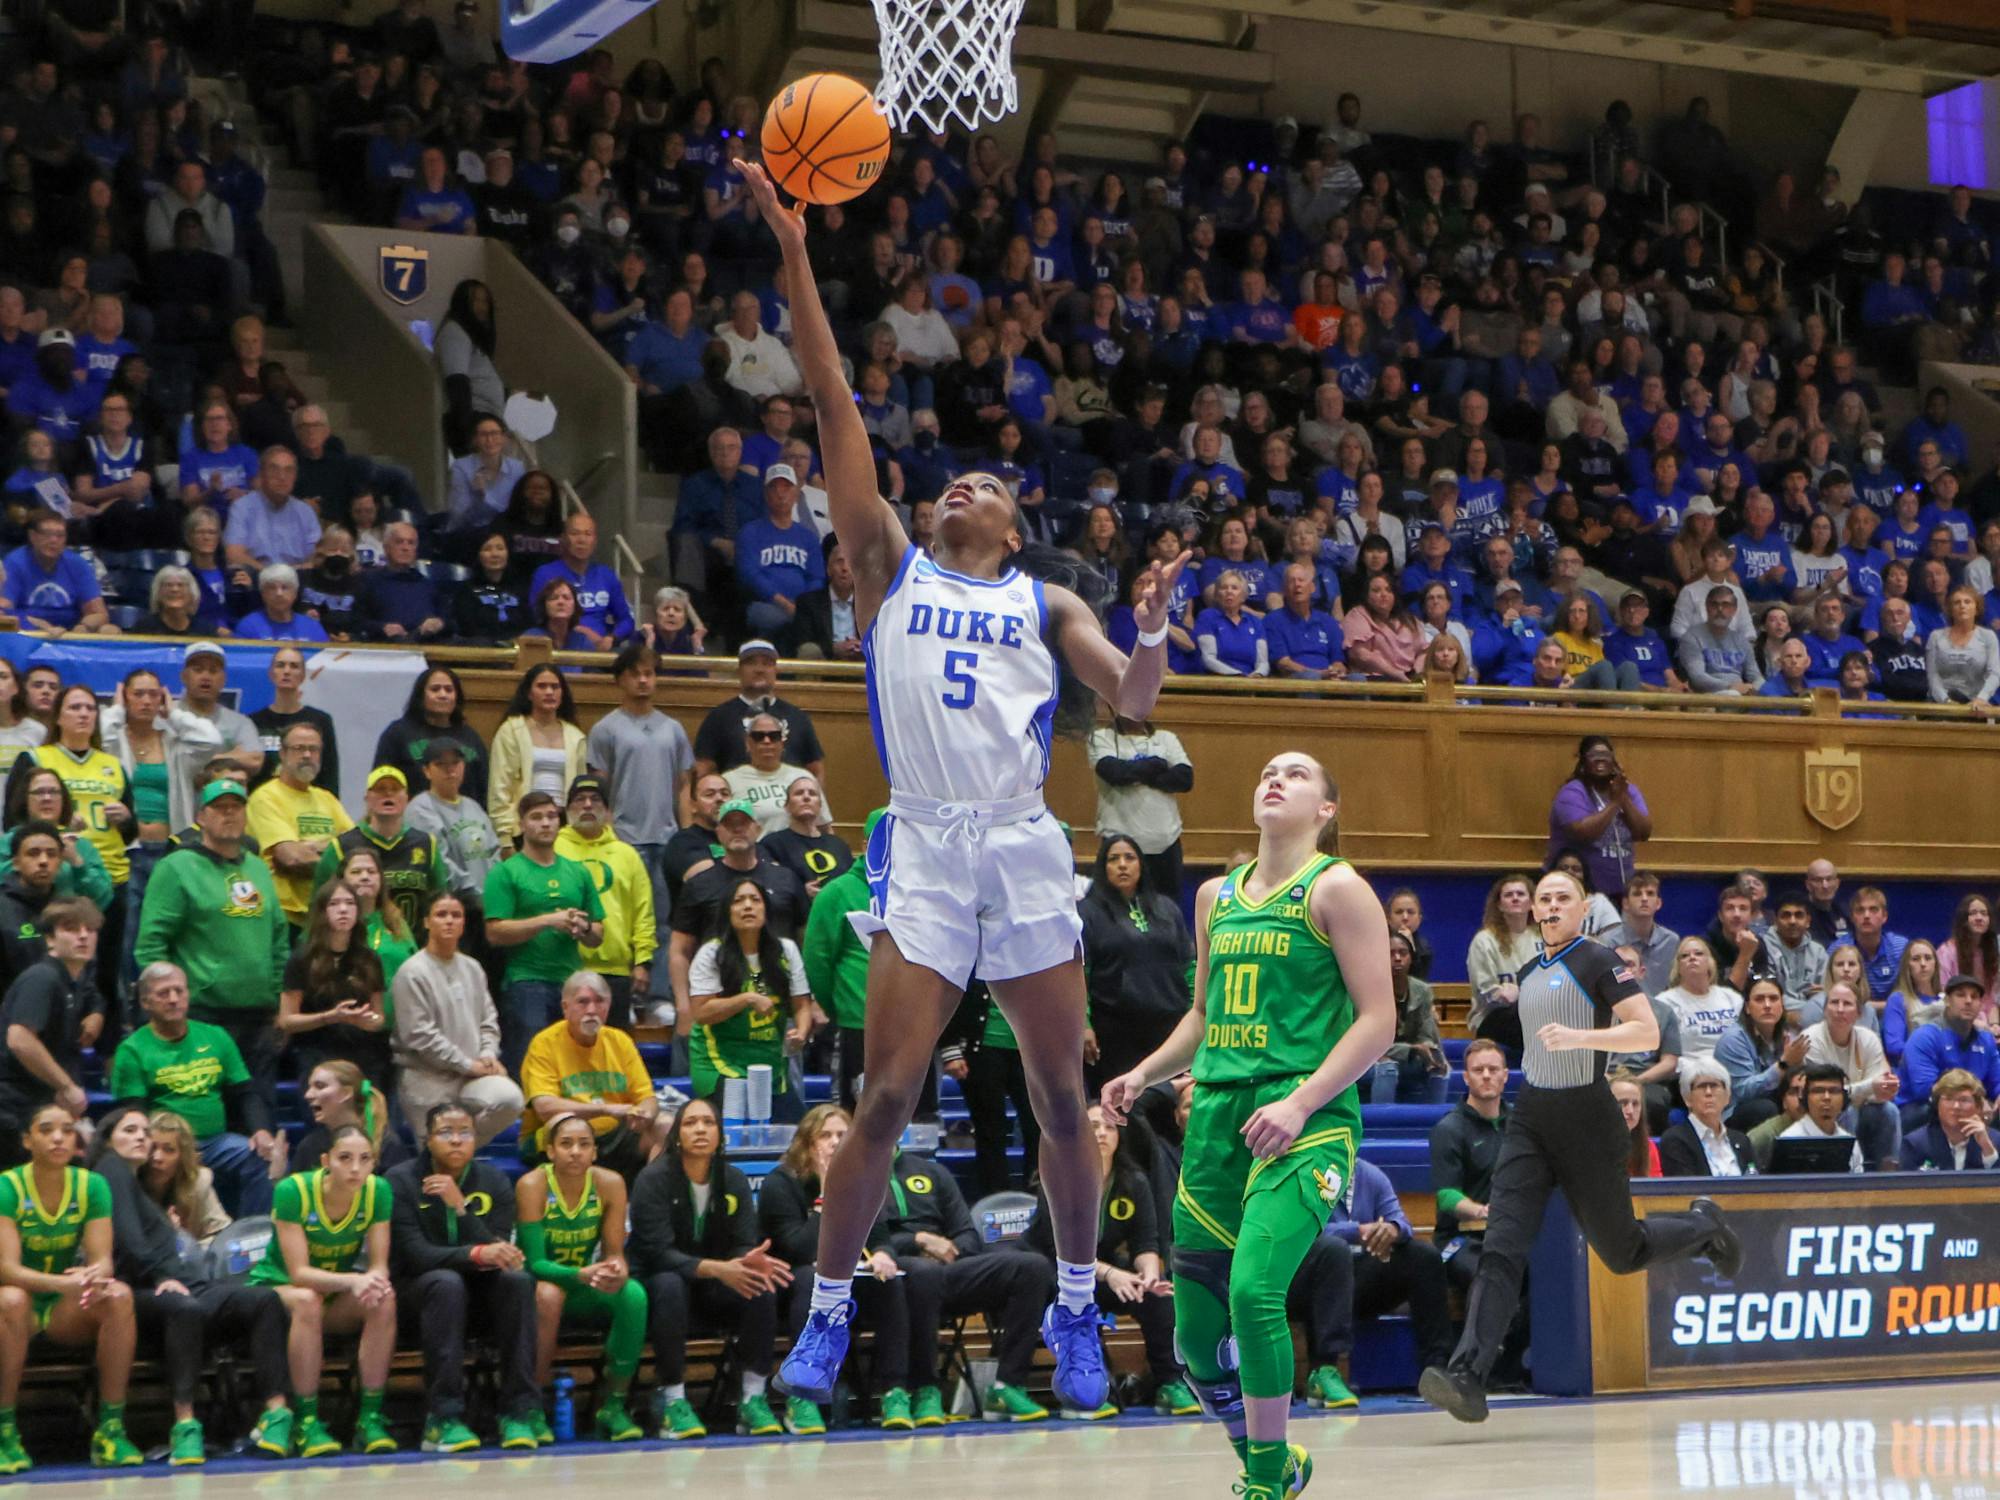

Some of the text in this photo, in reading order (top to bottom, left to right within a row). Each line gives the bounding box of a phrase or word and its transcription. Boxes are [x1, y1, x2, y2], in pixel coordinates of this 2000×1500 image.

[394, 261, 416, 292] 7
[760, 544, 808, 570] DUKE
[907, 604, 1024, 650] DUKE
[942, 650, 978, 710] 5
[1816, 770, 1854, 811] 19
[1224, 964, 1258, 1015] 10
[1207, 1024, 1268, 1049] DUCKS
[1786, 1223, 1979, 1276] FIRST AND
[1672, 1287, 1872, 1346] SECOND
